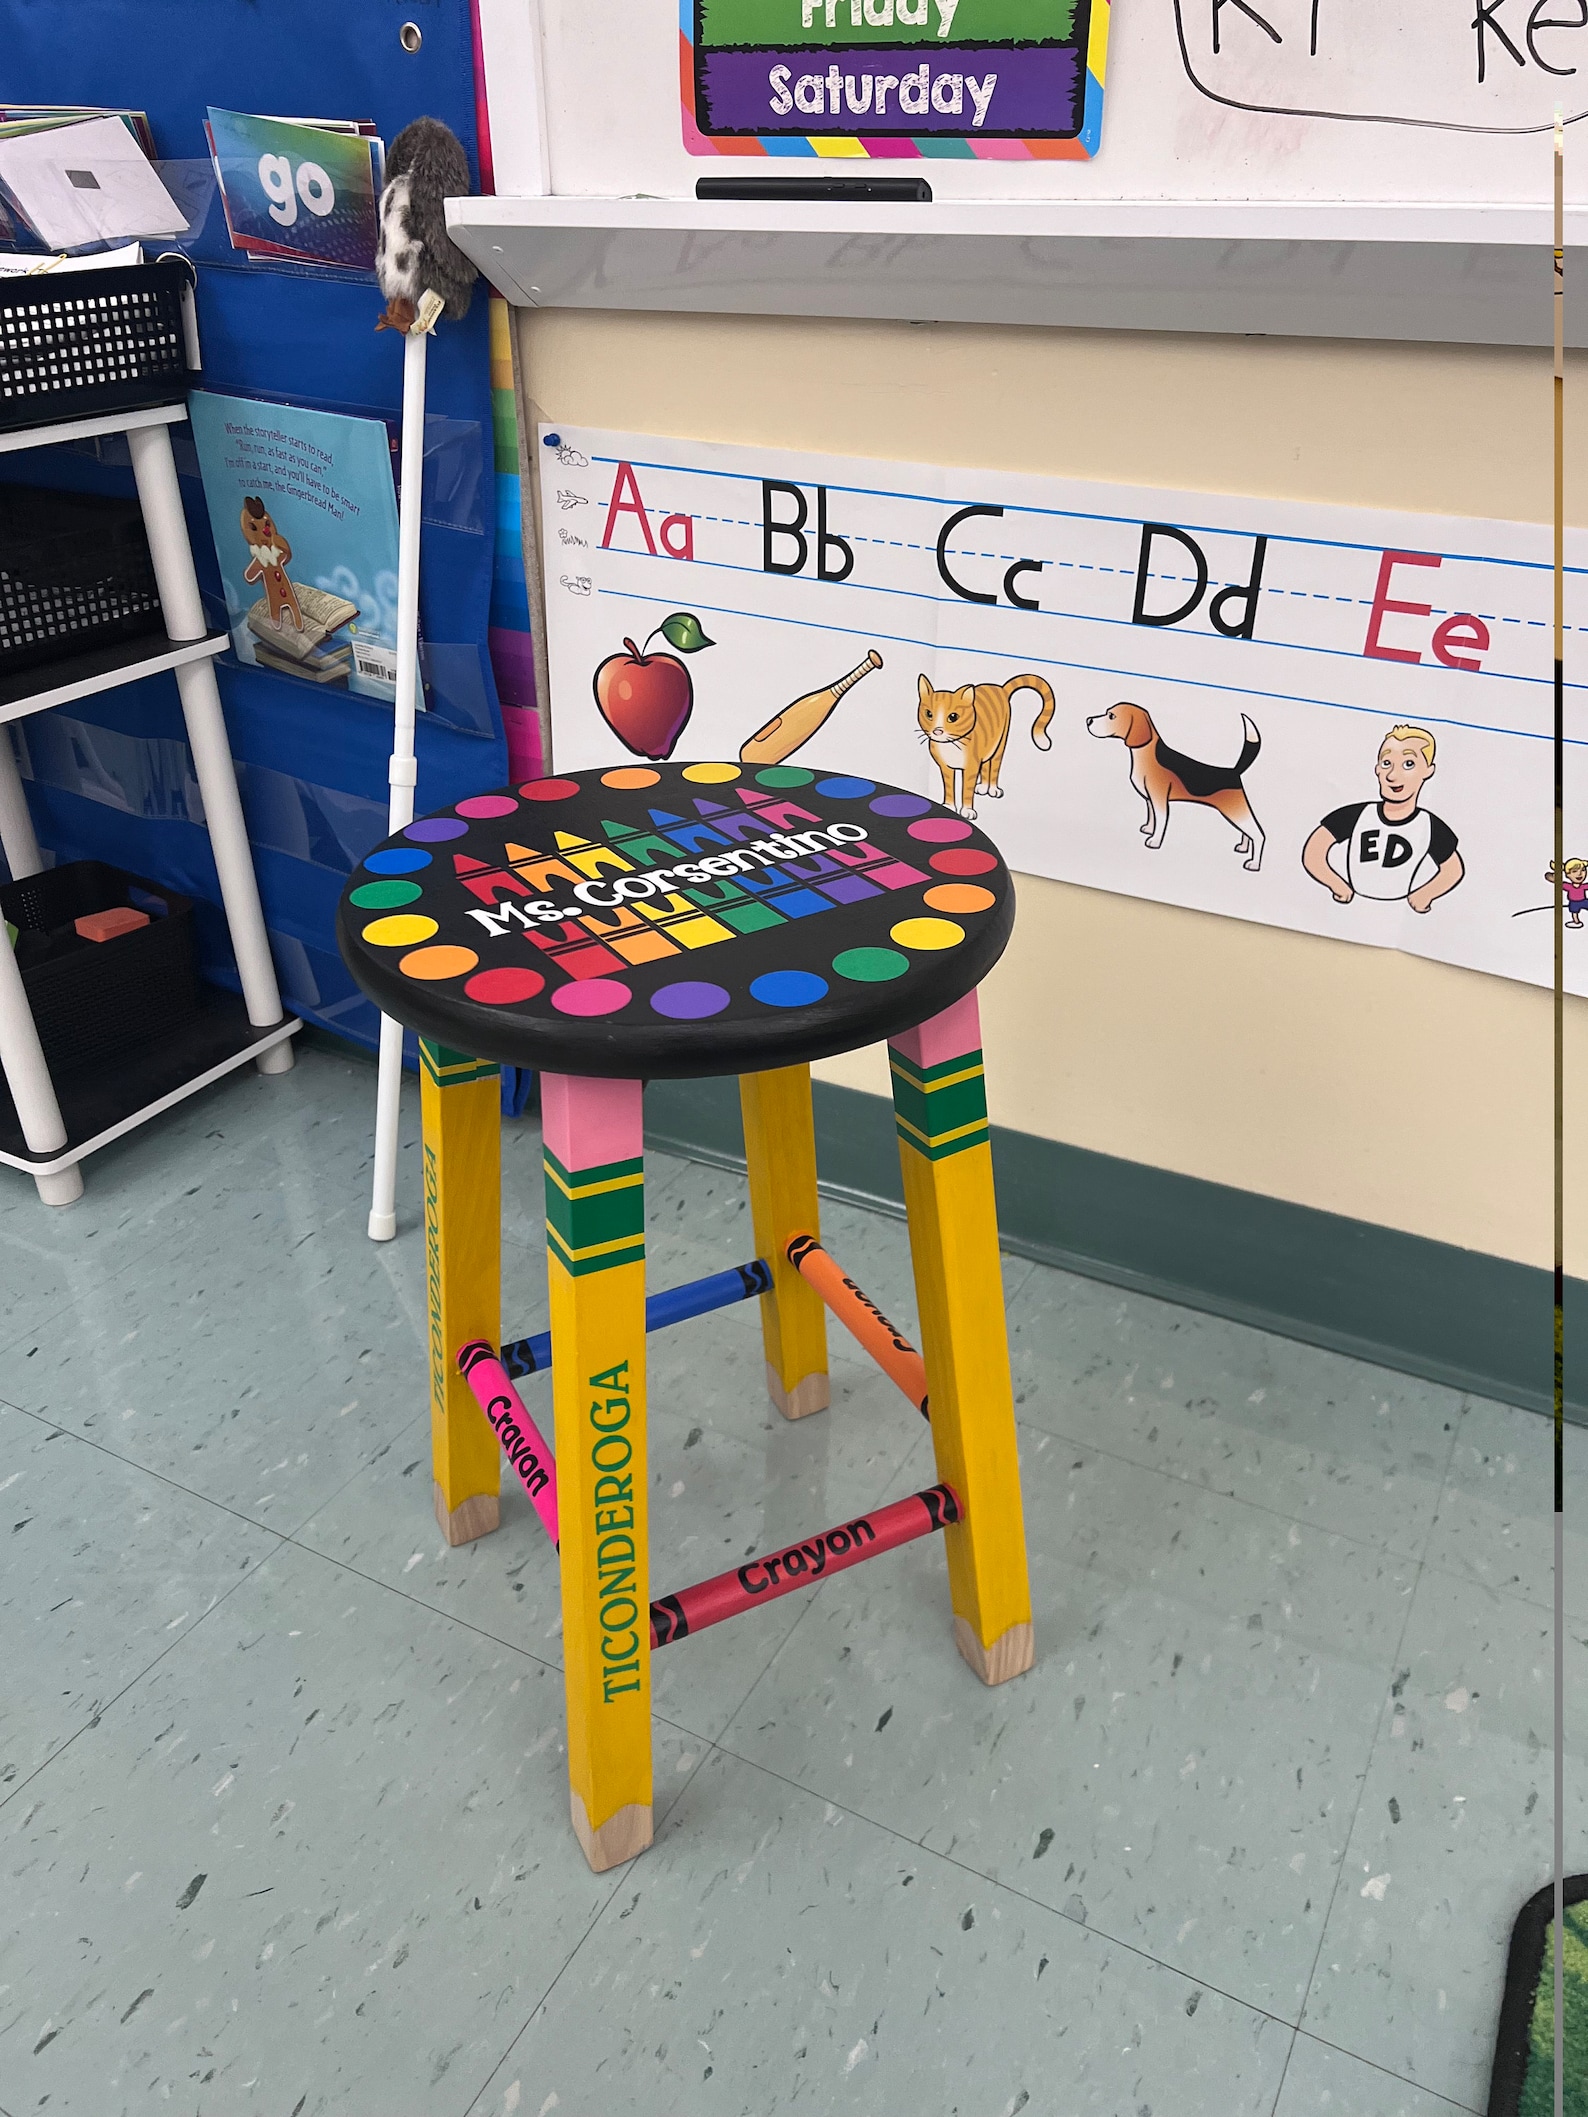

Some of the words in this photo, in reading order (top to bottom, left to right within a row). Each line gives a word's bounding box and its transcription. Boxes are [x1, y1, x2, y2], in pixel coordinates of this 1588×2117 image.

[802, 0, 959, 38] Friday
[768, 63, 998, 127] Saturday
[258, 153, 335, 227] go
[225, 422, 243, 436] When
[243, 424, 254, 436] the
[254, 427, 288, 443] storyteller
[289, 435, 307, 452] starts
[308, 442, 316, 455] to
[317, 448, 334, 467] read,
[253, 443, 267, 455] run,
[267, 446, 275, 457] as
[275, 447, 288, 460] fast
[288, 453, 296, 464] as
[296, 455, 309, 471] you
[235, 457, 245, 469] off
[252, 461, 257, 470] a
[257, 460, 274, 475] start,
[274, 465, 287, 477] and
[287, 467, 305, 484] you'll
[305, 475, 322, 491] have
[322, 483, 330, 496] to
[330, 487, 340, 502] be
[340, 495, 361, 516] smart
[238, 477, 246, 488] to
[246, 477, 263, 489] catch
[263, 480, 275, 492] me,
[274, 480, 286, 493] the
[286, 482, 327, 511] Gingerbread
[327, 502, 345, 522] Man!
[602, 461, 693, 562] Aa
[762, 480, 855, 583] Bb
[936, 505, 1043, 611] Cc
[1132, 523, 1267, 640] Dd
[1363, 550, 1491, 672] Ee
[464, 899, 583, 938] Ms.
[573, 822, 869, 907] Corsentino
[1359, 829, 1413, 868] ED
[424, 1143, 446, 1414] TICONDEROGA
[485, 1395, 550, 1499] Crayon
[589, 1359, 642, 1704] TICONDEROGA
[736, 1516, 876, 1596] Crayon
